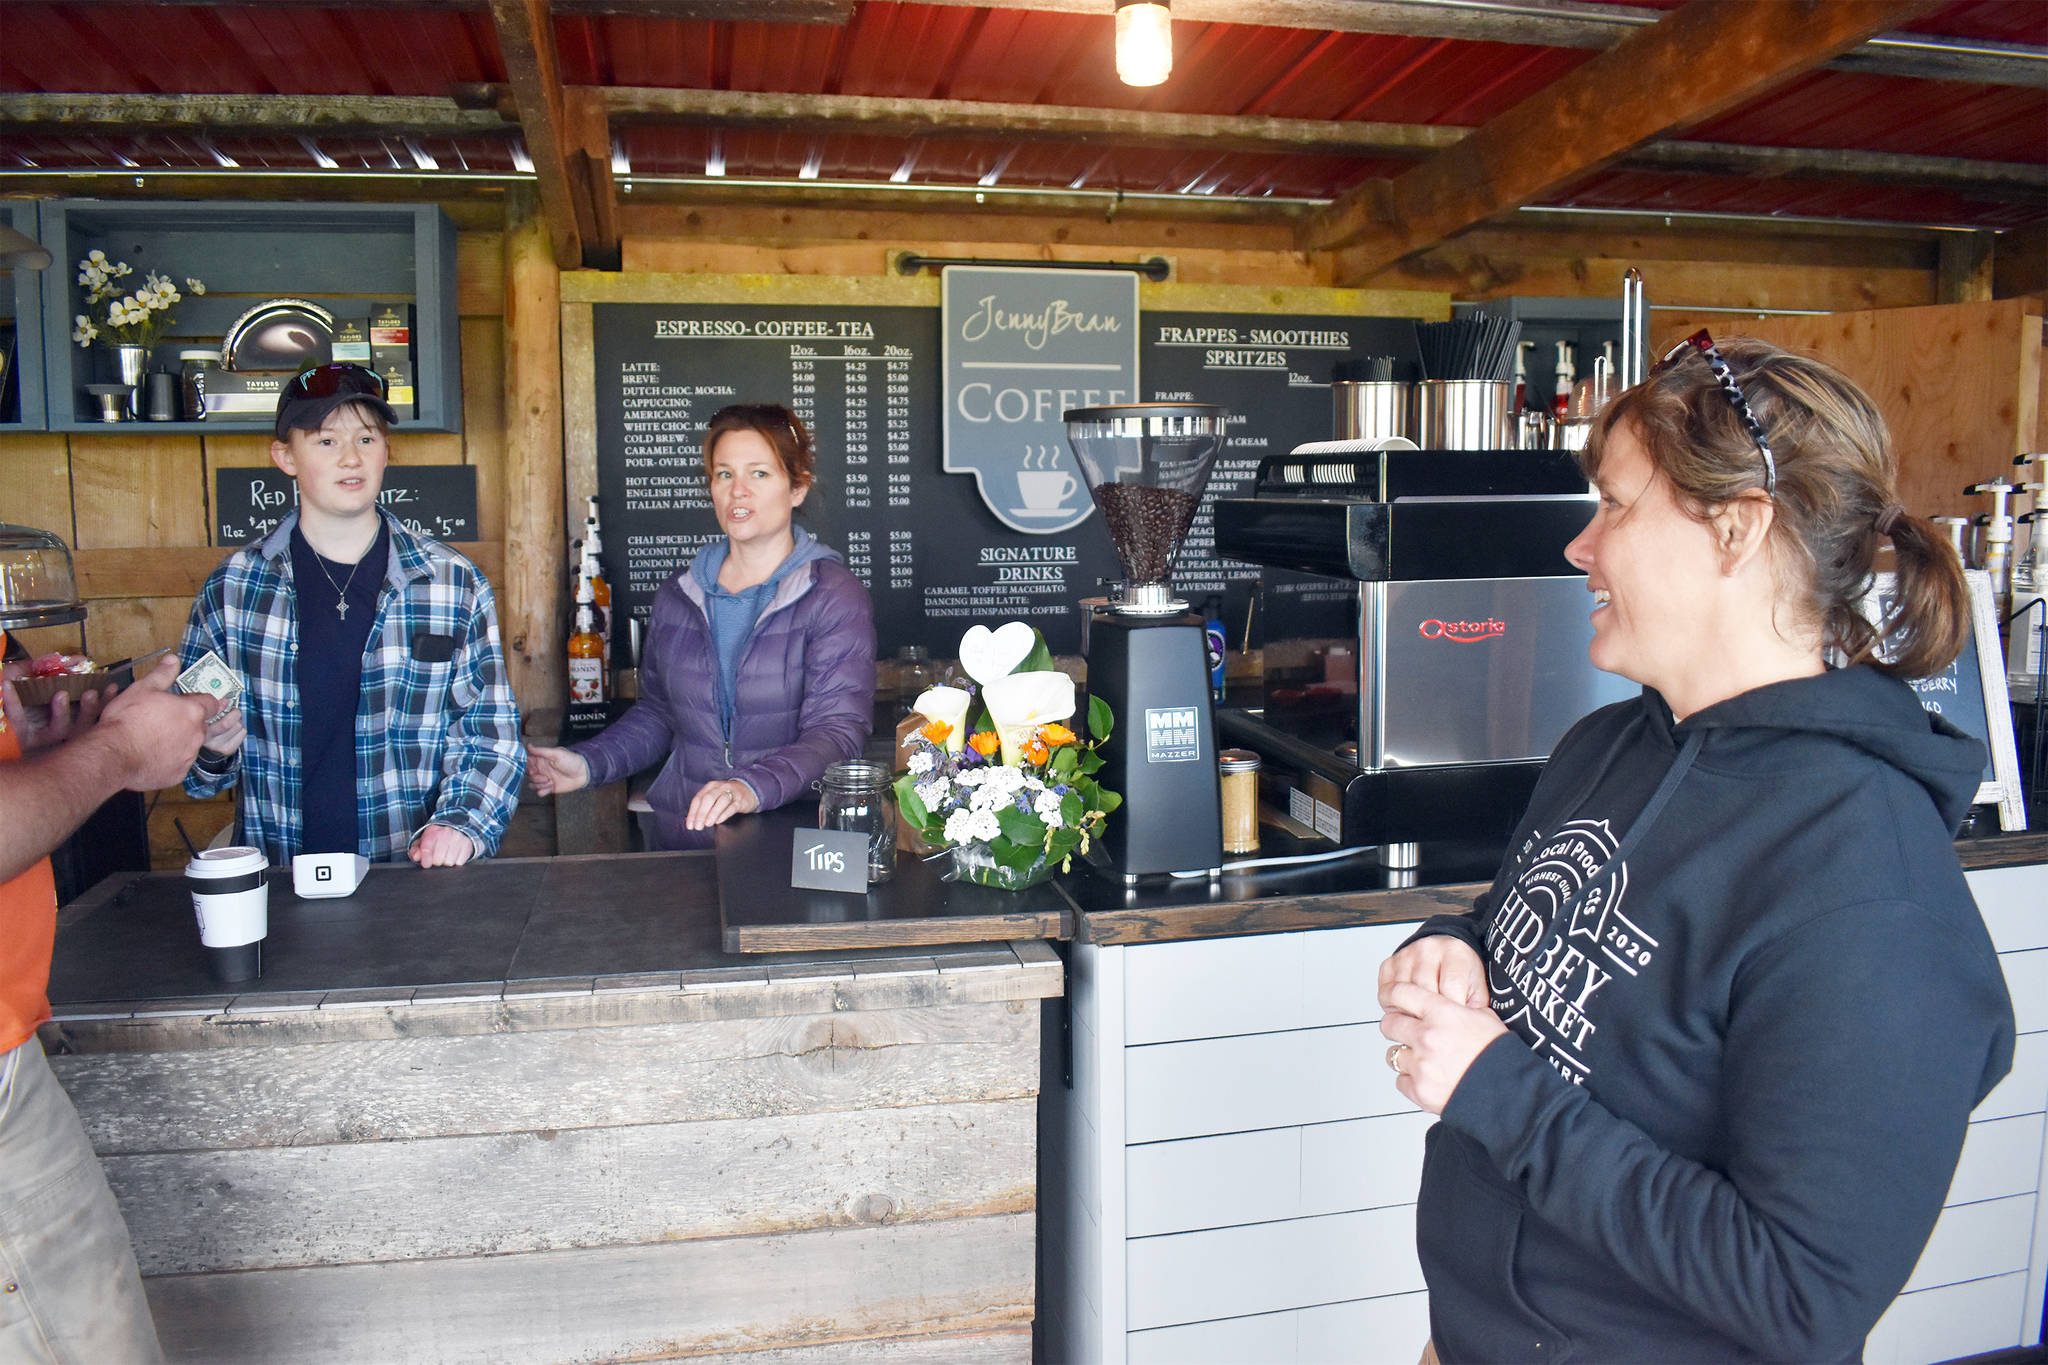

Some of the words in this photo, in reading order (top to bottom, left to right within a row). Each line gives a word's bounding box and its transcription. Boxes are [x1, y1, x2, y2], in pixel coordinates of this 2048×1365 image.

[837, 322, 874, 337] TEA
[1160, 327, 1237, 343] FRAPPES
[1250, 329, 1349, 346] SMOOTHIES
[1206, 350, 1286, 366] SPRITZES
[622, 362, 660, 372] LATTE:
[622, 374, 659, 384] BREVE:
[623, 386, 660, 396] DUTCH
[623, 398, 692, 408] CAPPUCCINO:
[624, 410, 689, 420] AMERICANO:
[624, 422, 660, 432] WHITE
[624, 434, 654, 444] COLD
[1235, 438, 1268, 447] CREAM
[625, 446, 677, 456] CARAMEL
[659, 457, 687, 467] OVER
[626, 476, 648, 486] HOT
[650, 476, 706, 486] CHOCOLAT
[627, 488, 672, 498] ENGLISH
[627, 500, 671, 510] ITALIAN
[628, 535, 653, 545] CHAI
[655, 535, 691, 544] SPICED
[628, 547, 679, 556] COCONUT
[980, 546, 1077, 562] SIGNATURE
[629, 559, 673, 568] LONDON
[630, 571, 652, 580] HOT
[999, 566, 1063, 581] DRINKS
[1228, 570, 1261, 579] LEMON
[924, 586, 970, 595] CARAMEL
[971, 586, 1008, 595] TOFFEE
[1009, 584, 1067, 594] MACCHIATO:
[1176, 582, 1226, 592] LAVENDER
[925, 597, 968, 606] DANCING
[969, 596, 994, 605] IRISH
[996, 596, 1030, 605] LATTE:
[925, 608, 970, 617] VIENNESE
[972, 607, 1030, 616] EINSPANNER
[1031, 605, 1069, 615] COFFEE:
[570, 712, 606, 721] MONIN
[1151, 751, 1195, 759] MAZZER
[1494, 886, 1612, 1014] HIDBEY
[1605, 926, 1652, 966] 2020
[1504, 949, 1596, 1052] MARKET
